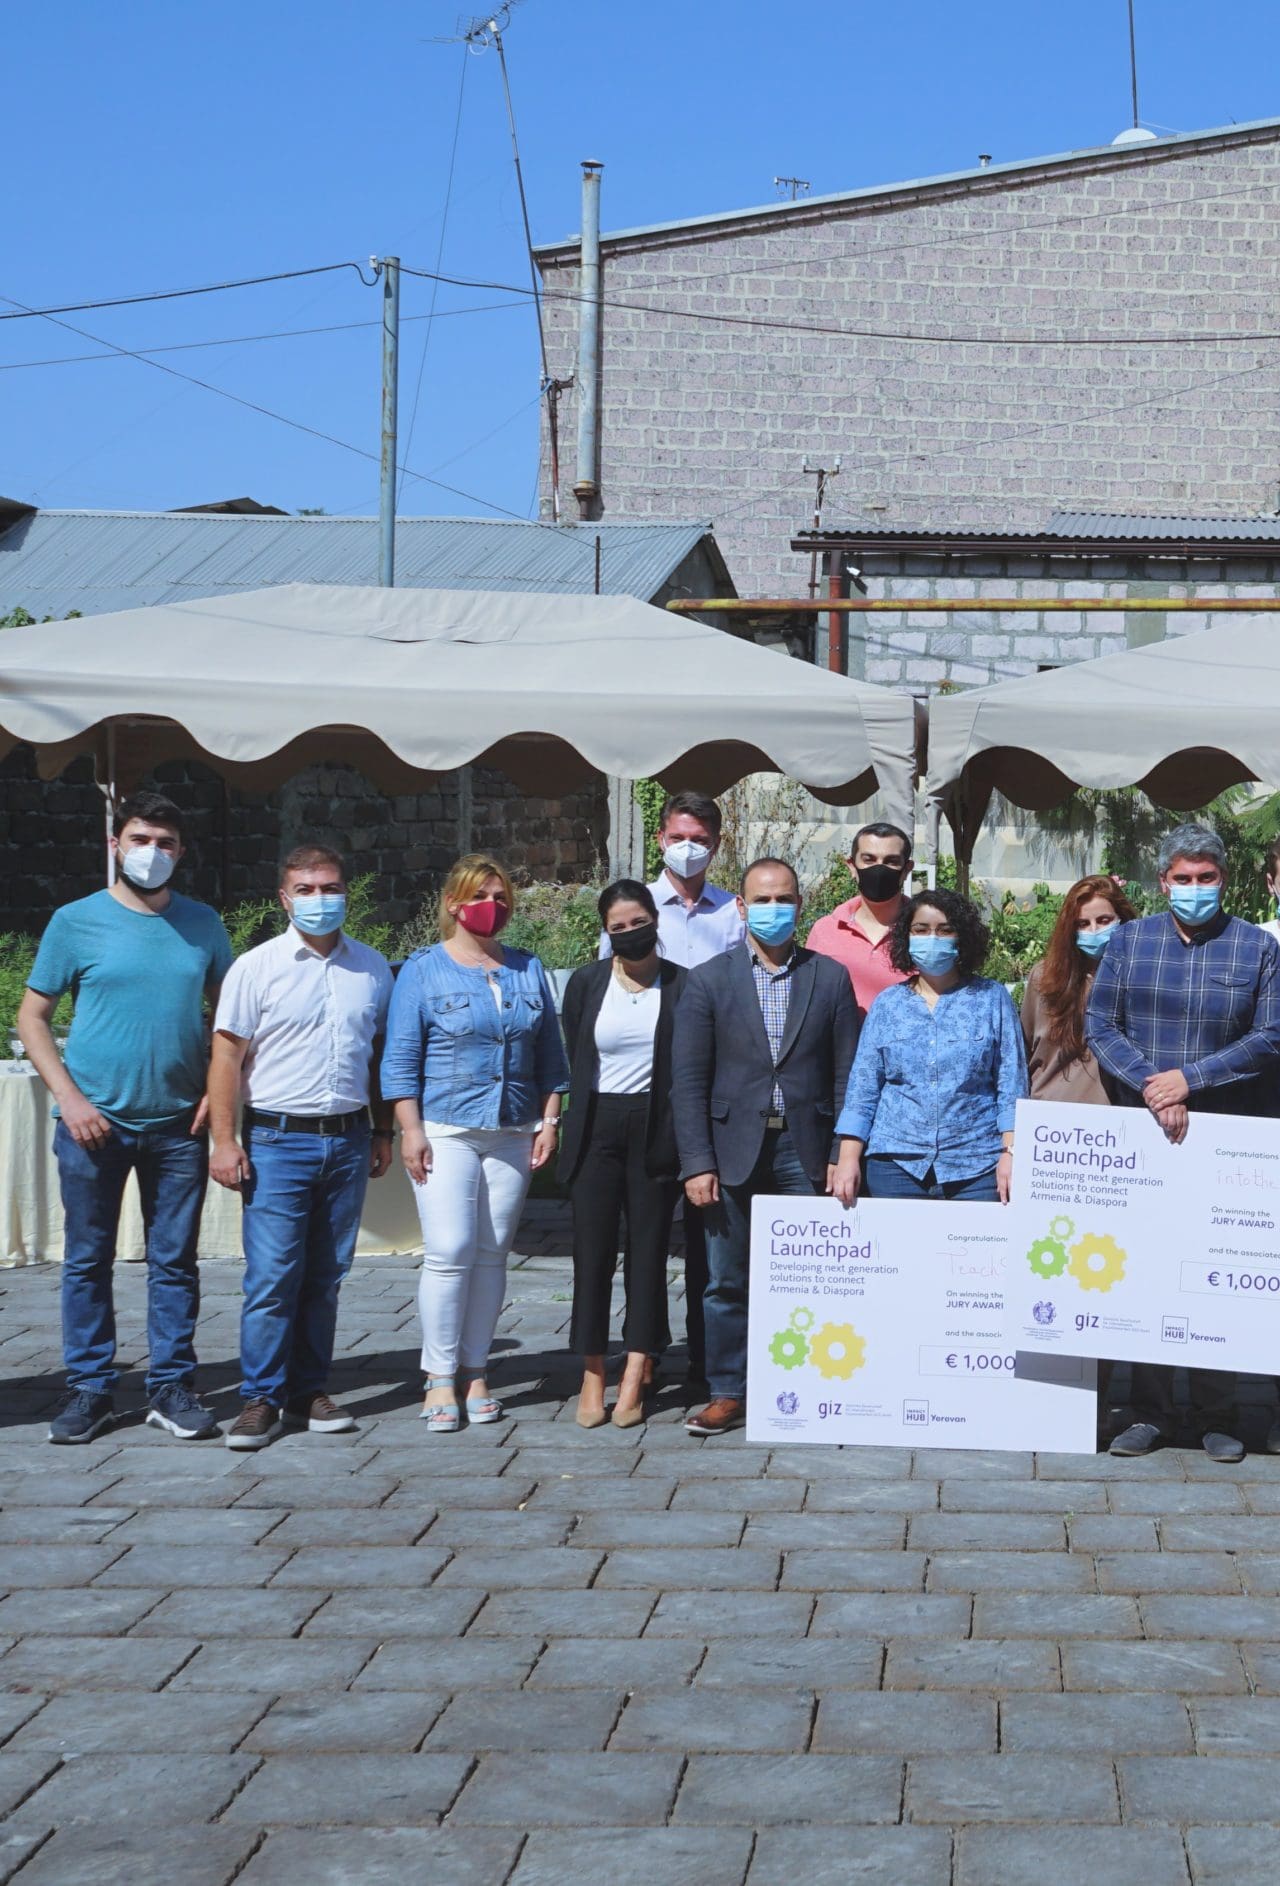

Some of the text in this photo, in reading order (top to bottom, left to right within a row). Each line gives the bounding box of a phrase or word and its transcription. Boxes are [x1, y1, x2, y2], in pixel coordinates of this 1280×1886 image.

[1034, 1126, 1116, 1148] GovTech
[1033, 1145, 1136, 1172] Launchpad
[1216, 1148, 1279, 1160] Congratulations
[1032, 1168, 1163, 1186] Developing next generation
[1031, 1180, 1128, 1195] solutions to connect
[1031, 1191, 1127, 1208] Armenia & Diaspora
[1226, 1208, 1255, 1217] winning
[771, 1220, 851, 1238] GovTech
[1238, 1219, 1275, 1229] AWARD
[771, 1240, 871, 1262] Launchpad
[770, 1262, 822, 1274] Developing
[848, 1265, 899, 1275] generation
[770, 1273, 865, 1284] solutions to connect
[1208, 1272, 1280, 1291] € 1,000
[769, 1285, 864, 1297] Armenia & Diaspora
[960, 1291, 988, 1299] winning
[1075, 1313, 1099, 1331] giz
[1164, 1331, 1226, 1343] HUB Yerevan
[945, 1354, 1016, 1371] € 1,000
[818, 1401, 842, 1418] giz
[931, 1415, 966, 1423] Yerevan
